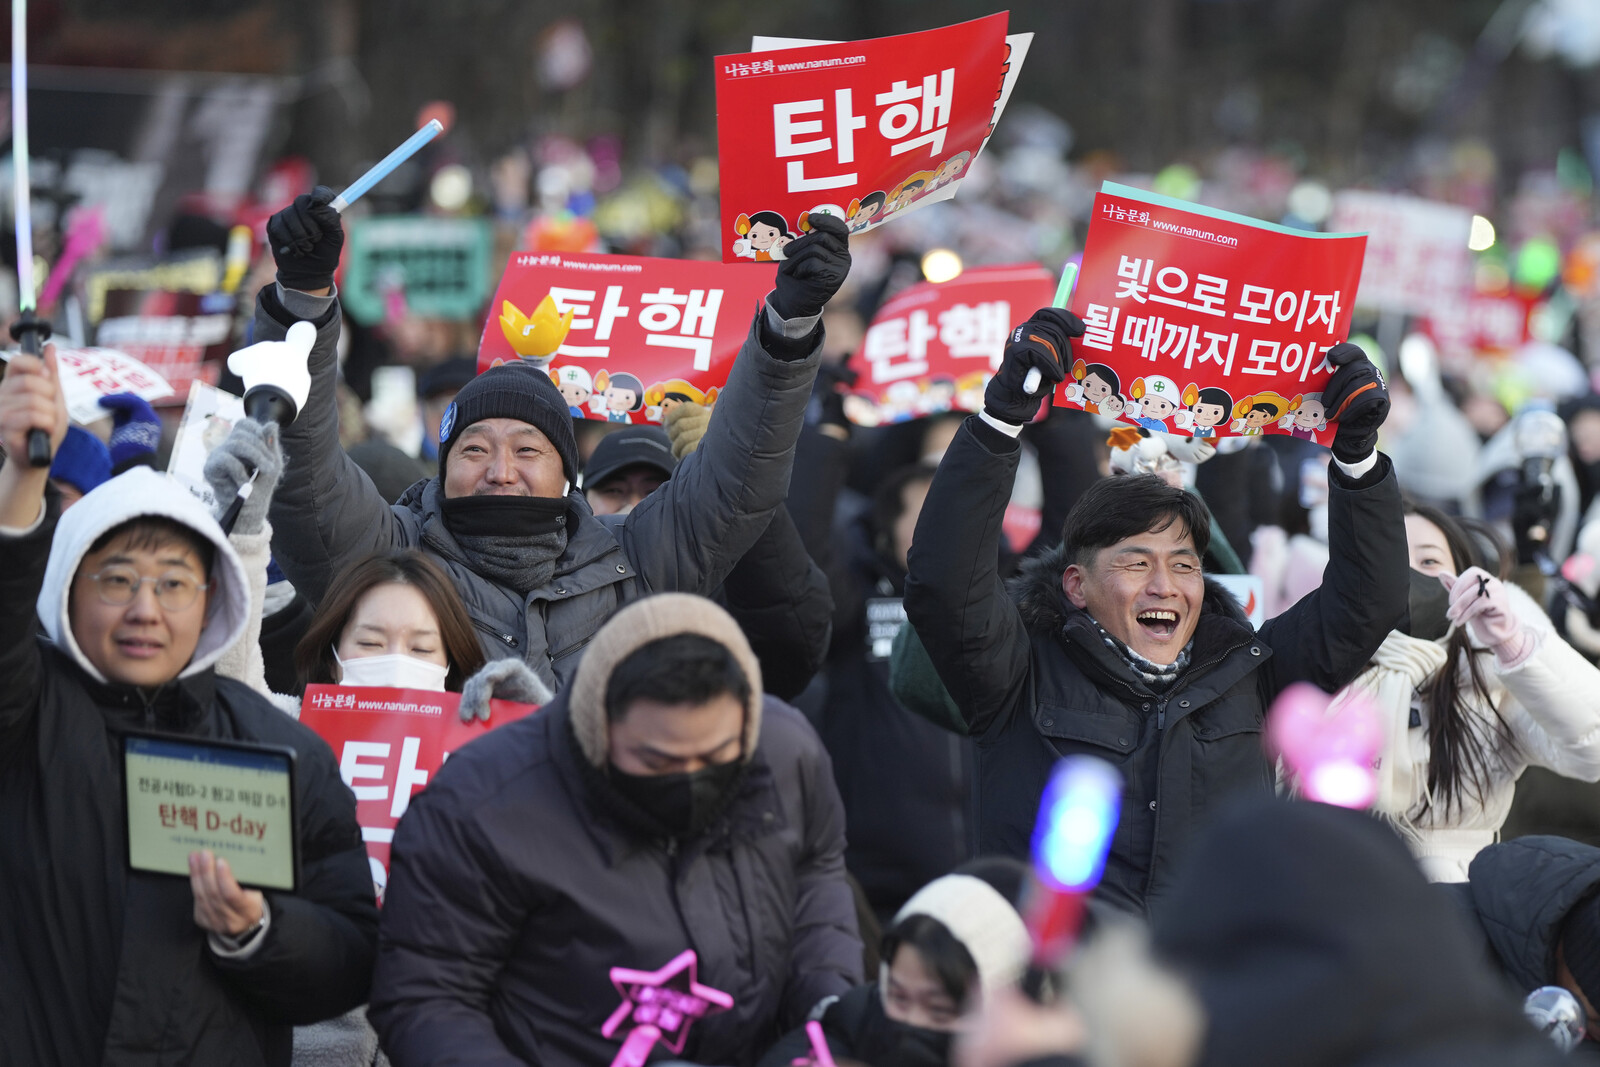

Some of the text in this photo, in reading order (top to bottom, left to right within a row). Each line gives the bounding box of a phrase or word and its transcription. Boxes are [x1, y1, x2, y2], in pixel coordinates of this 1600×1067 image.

[725, 56, 866, 77] 나눔문화 www.nanum.com
[773, 68, 955, 193] 탄핵
[1102, 204, 1238, 247] 나눔문화 www.nanum.com
[562, 260, 643, 273] www.nanum.com
[1115, 255, 1341, 334] 빛으로 모이자
[549, 285, 725, 372] 탄핵
[864, 300, 1011, 384] 탄핵
[1082, 303, 1120, 352] 될
[1121, 315, 1239, 377] 때까지
[312, 693, 443, 715] 나눔문화 www.nanum.com
[158, 803, 267, 842] 탄핵 D-day
